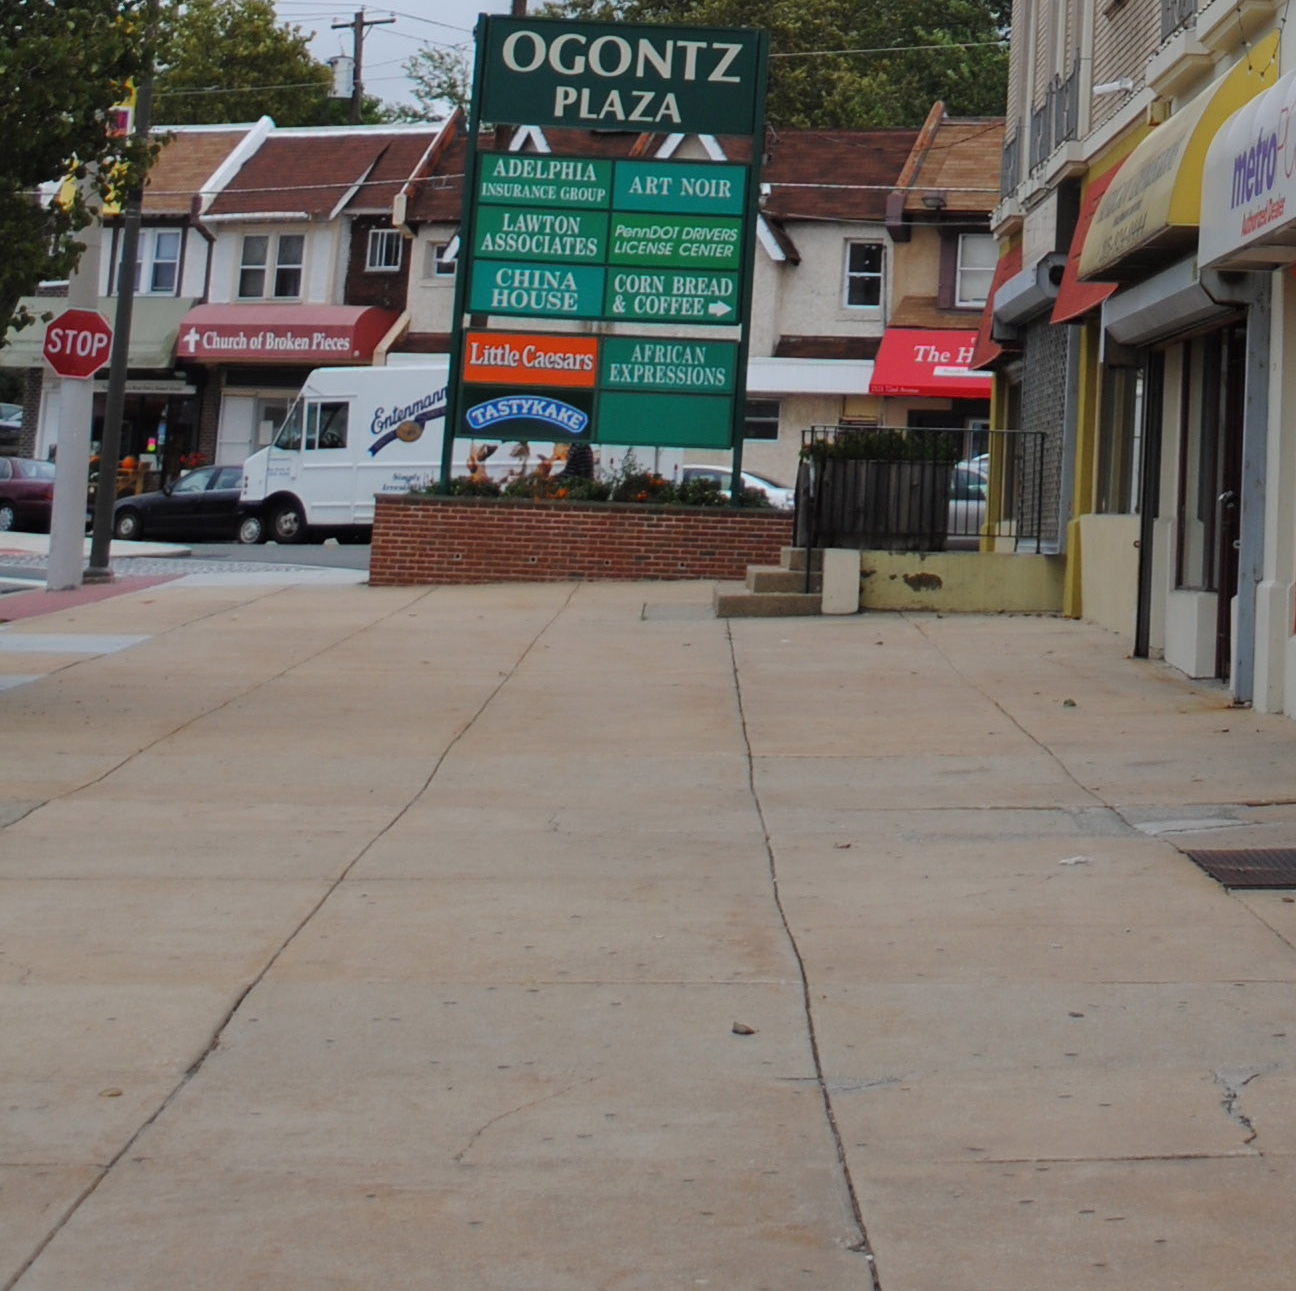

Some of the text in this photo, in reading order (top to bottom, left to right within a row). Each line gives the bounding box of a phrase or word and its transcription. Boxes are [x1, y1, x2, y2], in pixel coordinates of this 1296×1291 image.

[502, 30, 744, 84] OGONTZ
[553, 86, 682, 123] PLAZA
[492, 158, 597, 182] ADELPHIA
[481, 182, 606, 204] INSURANCE GROUP
[628, 175, 732, 199] ART NOIR
[502, 212, 581, 235] LAWTON
[614, 224, 738, 243] PennDOT DRIVERS
[480, 232, 598, 258] ASSOCIATES
[614, 240, 734, 259] LICENSE CENTER
[495, 267, 578, 291] CHINA
[614, 273, 733, 297] CORN BREAD
[491, 289, 578, 312] HOUSE
[612, 295, 705, 317] & COFFEE
[47, 328, 109, 358] STOP
[202, 330, 351, 353] Church of Broken Pieces
[469, 341, 593, 372] Little Caesars
[631, 344, 706, 366] AFRICAN
[913, 345, 951, 363] The
[609, 363, 726, 387] EXPRESSIONS
[472, 398, 586, 431] TASTYKAKE
